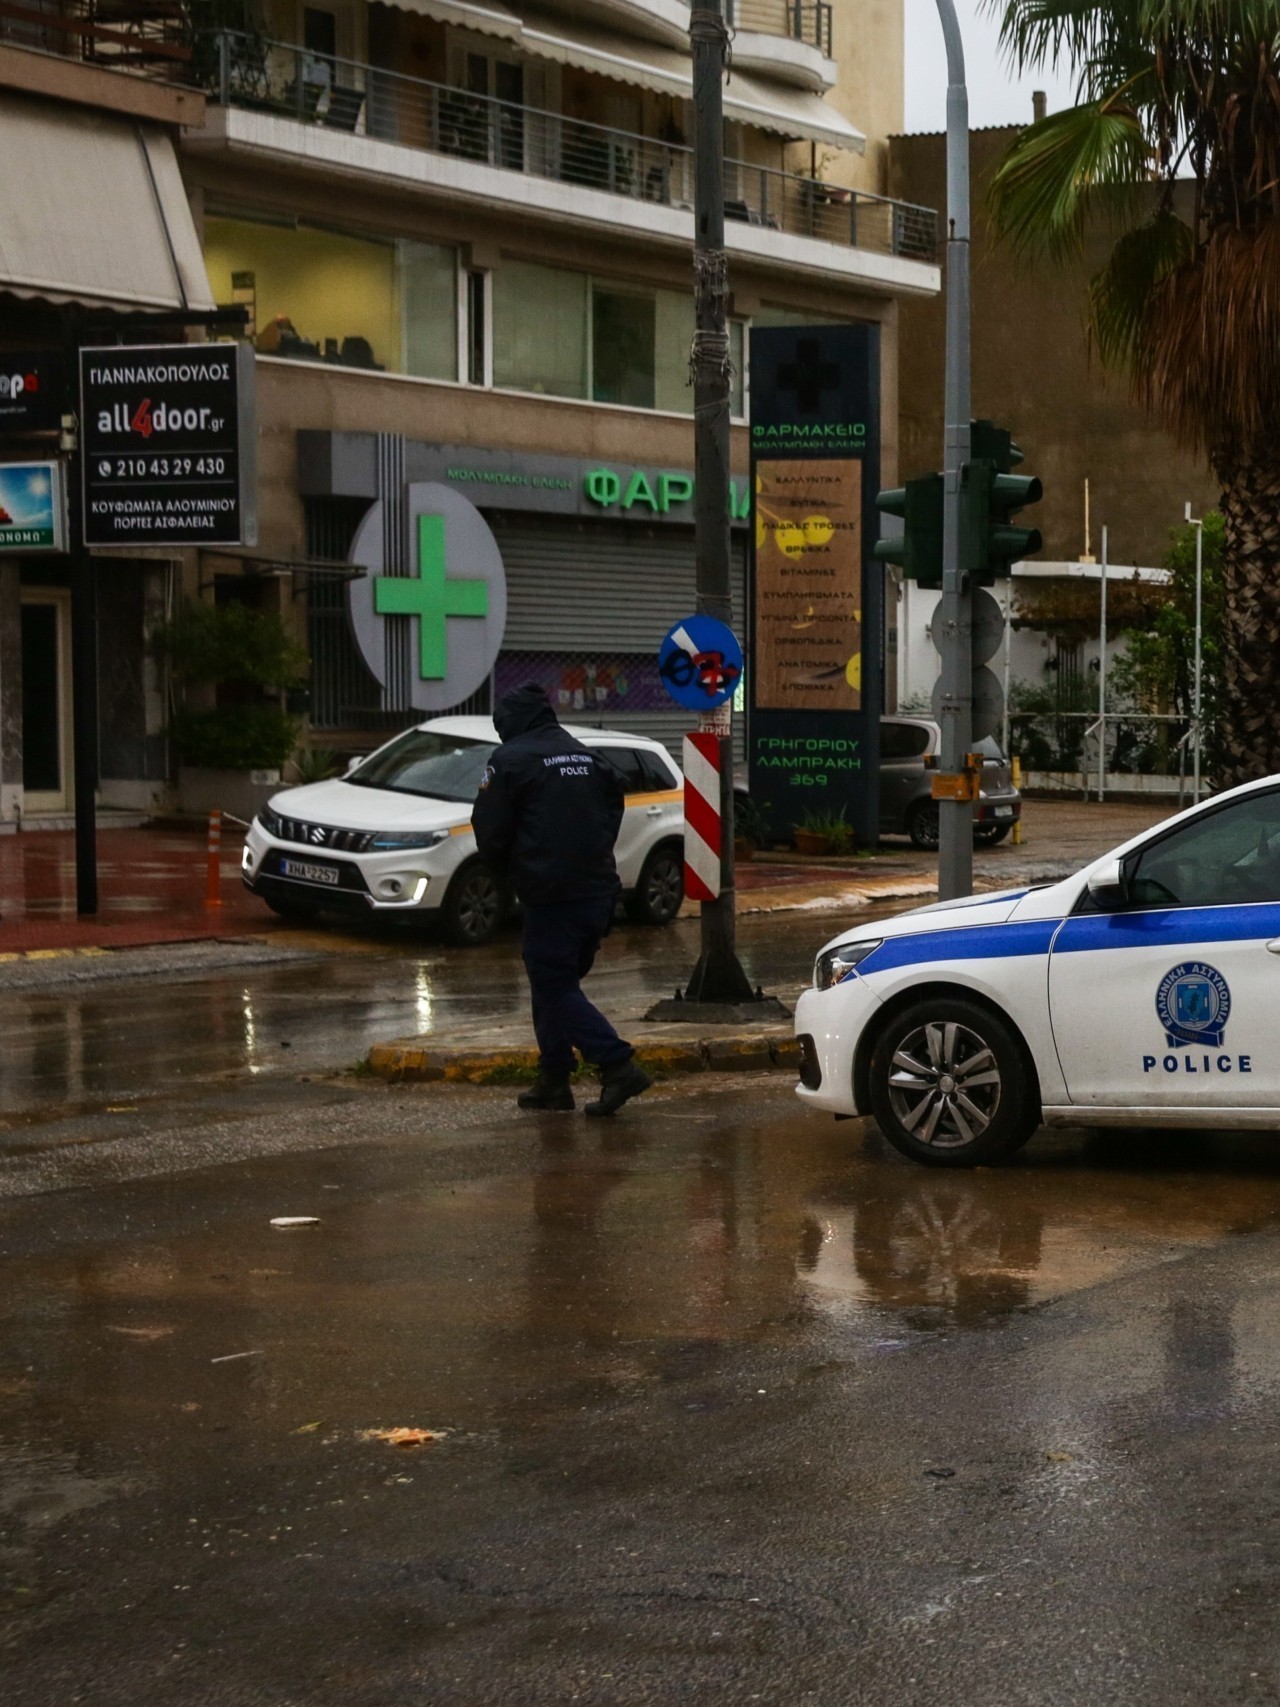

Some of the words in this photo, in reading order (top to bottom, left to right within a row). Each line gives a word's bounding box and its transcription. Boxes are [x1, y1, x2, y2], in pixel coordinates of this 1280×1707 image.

[90, 363, 230, 385] ΓΙΑΝΝΑΚΟΠΟΥΛΟΣ
[98, 397, 225, 438] all4door.gr
[753, 423, 866, 437] ΦΑΡΜΑΚΕΙΟ
[117, 460, 146, 477] 210
[150, 459, 169, 476] 43
[173, 458, 192, 475] 29
[196, 457, 225, 475] 430
[91, 501, 163, 513] ΚΟΥΦΩΜΑΤΑ
[166, 499, 236, 512] ΑΛΟΥΜΙΝΙΟΥ
[114, 517, 152, 529] ΠΟΡΤΕΣ
[154, 516, 215, 528] ΑΣΦΑΛΕΙΑΣ
[758, 738, 859, 751] ΓΡΗΓΟΡΙΟΥ
[757, 756, 861, 769] ΛΑΜΠΡΑΚΗ
[560, 766, 589, 776] POLICE
[790, 774, 828, 786] 369
[1158, 966, 1186, 1028] ΕΛΛΗΝΙΚΗ
[1191, 964, 1230, 1024] ΑΣΤΥΝΟΜΙΑ
[1143, 1055, 1252, 1073] POLICE
